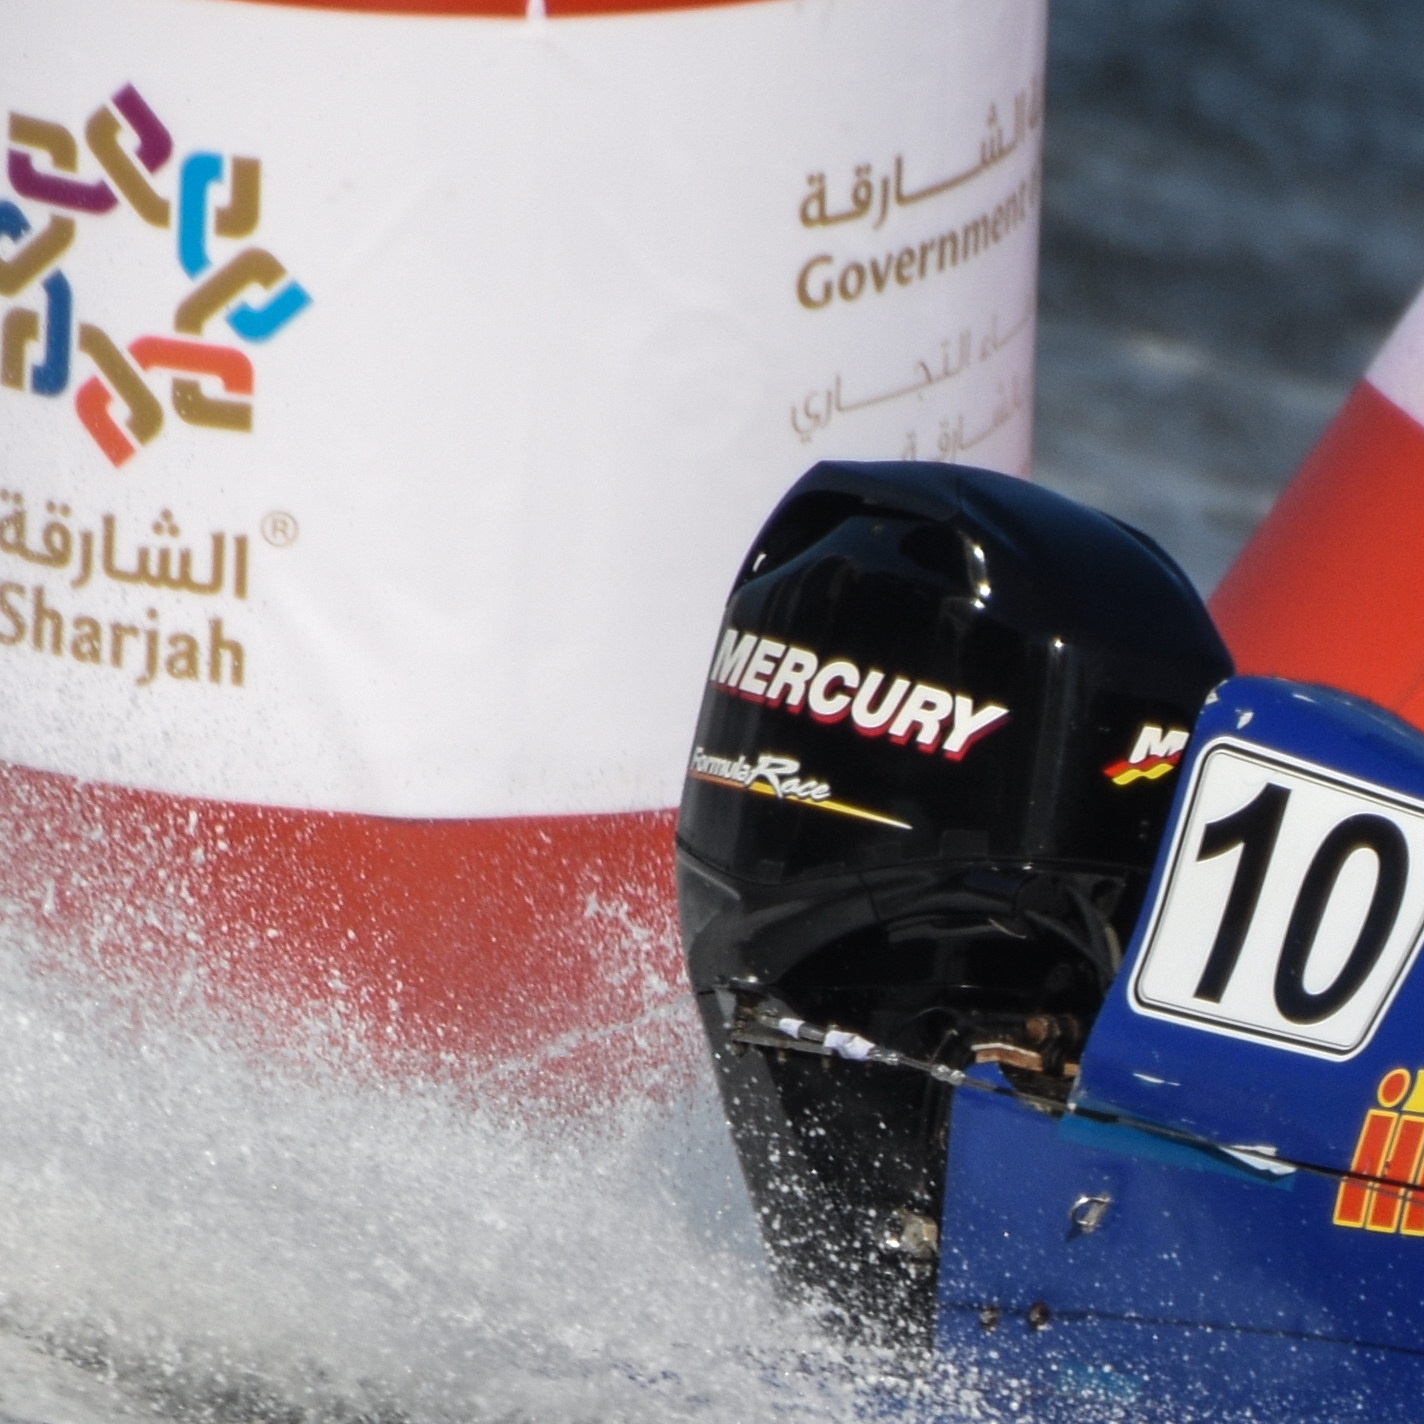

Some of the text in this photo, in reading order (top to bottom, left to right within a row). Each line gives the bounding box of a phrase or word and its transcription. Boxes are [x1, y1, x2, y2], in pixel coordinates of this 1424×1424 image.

[0, 580, 245, 687] Sharjah
[711, 629, 1012, 762] MERCURY
[1192, 782, 1411, 1026] 10
